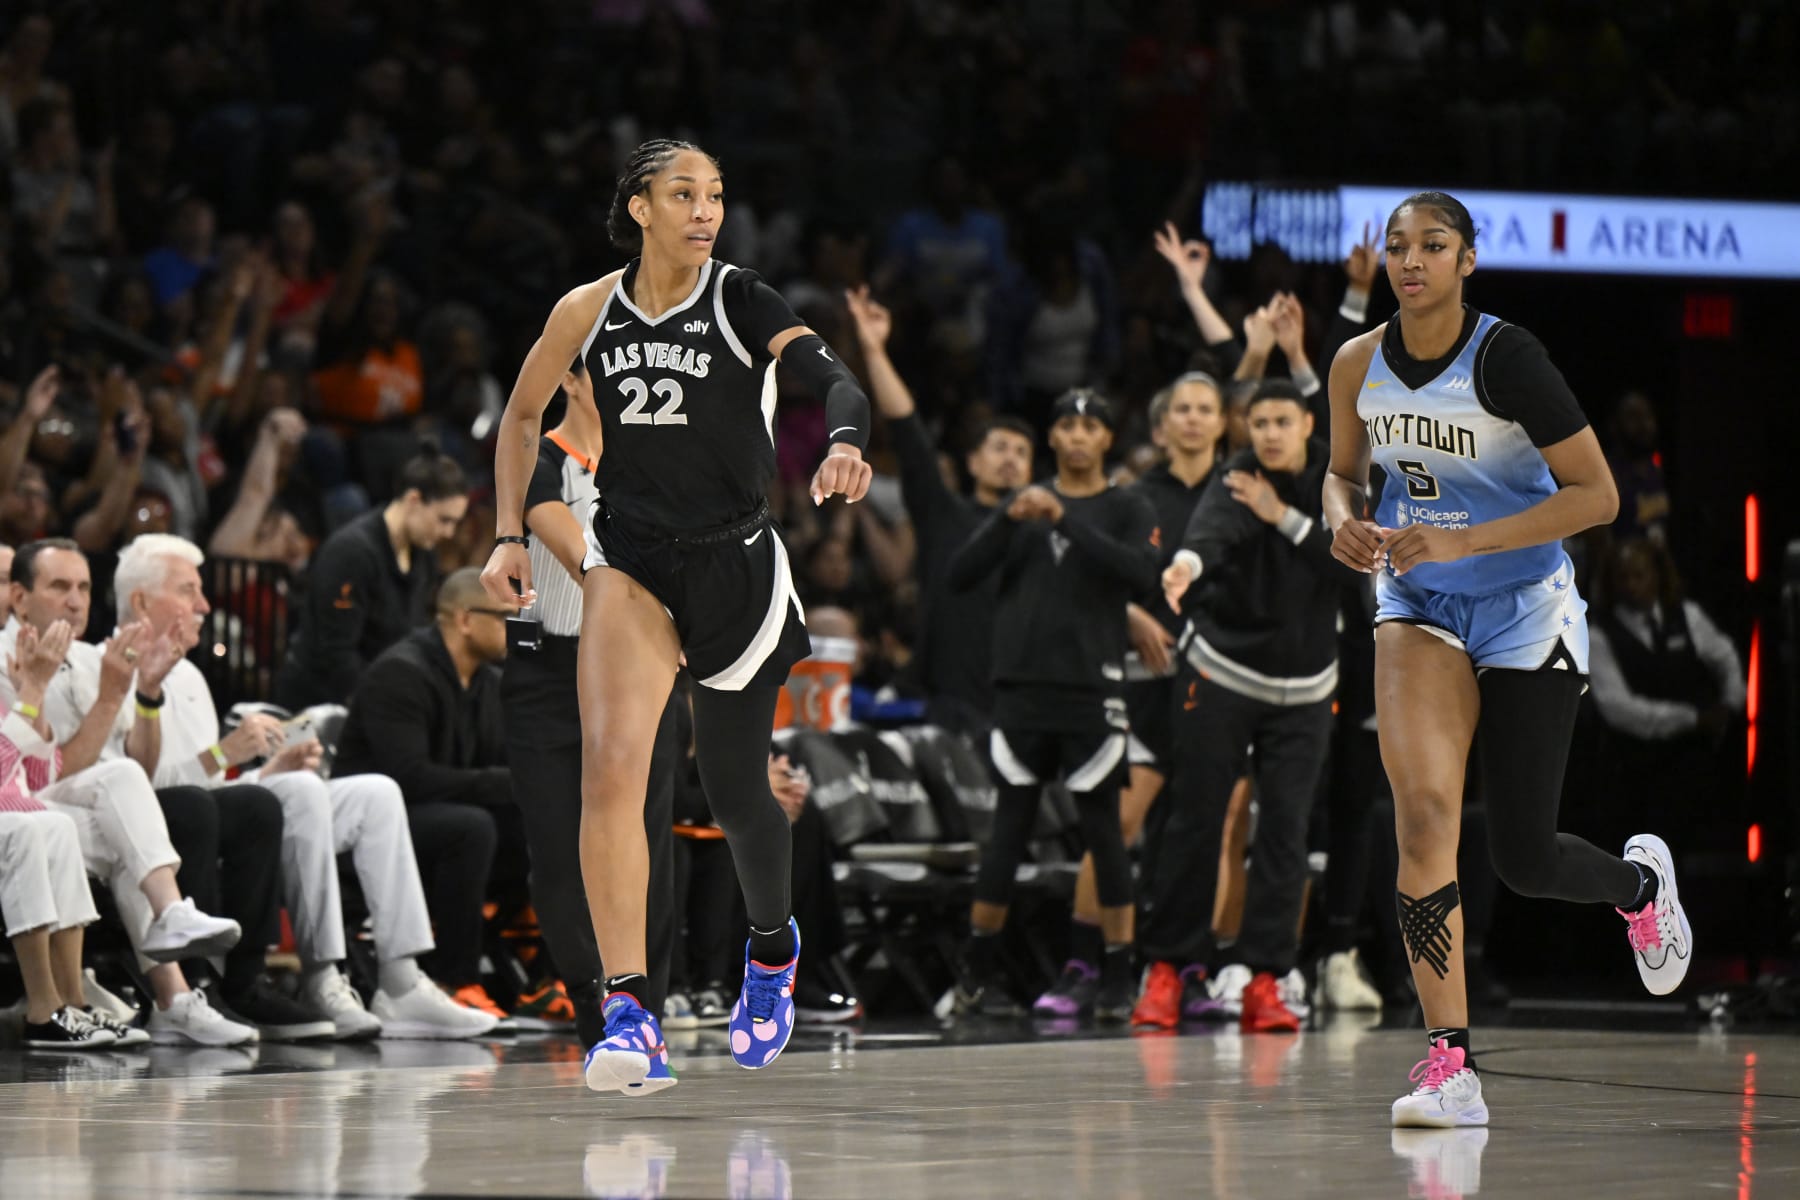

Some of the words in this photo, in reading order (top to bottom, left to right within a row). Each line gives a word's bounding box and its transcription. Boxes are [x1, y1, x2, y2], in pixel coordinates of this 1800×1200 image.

[1588, 213, 1742, 260] ARENA
[683, 320, 710, 335] ally
[600, 343, 642, 377] LAS
[643, 342, 712, 378] VEGAS
[617, 376, 688, 425] 22
[1396, 459, 1440, 500] 5
[1409, 505, 1469, 522] UChicago
